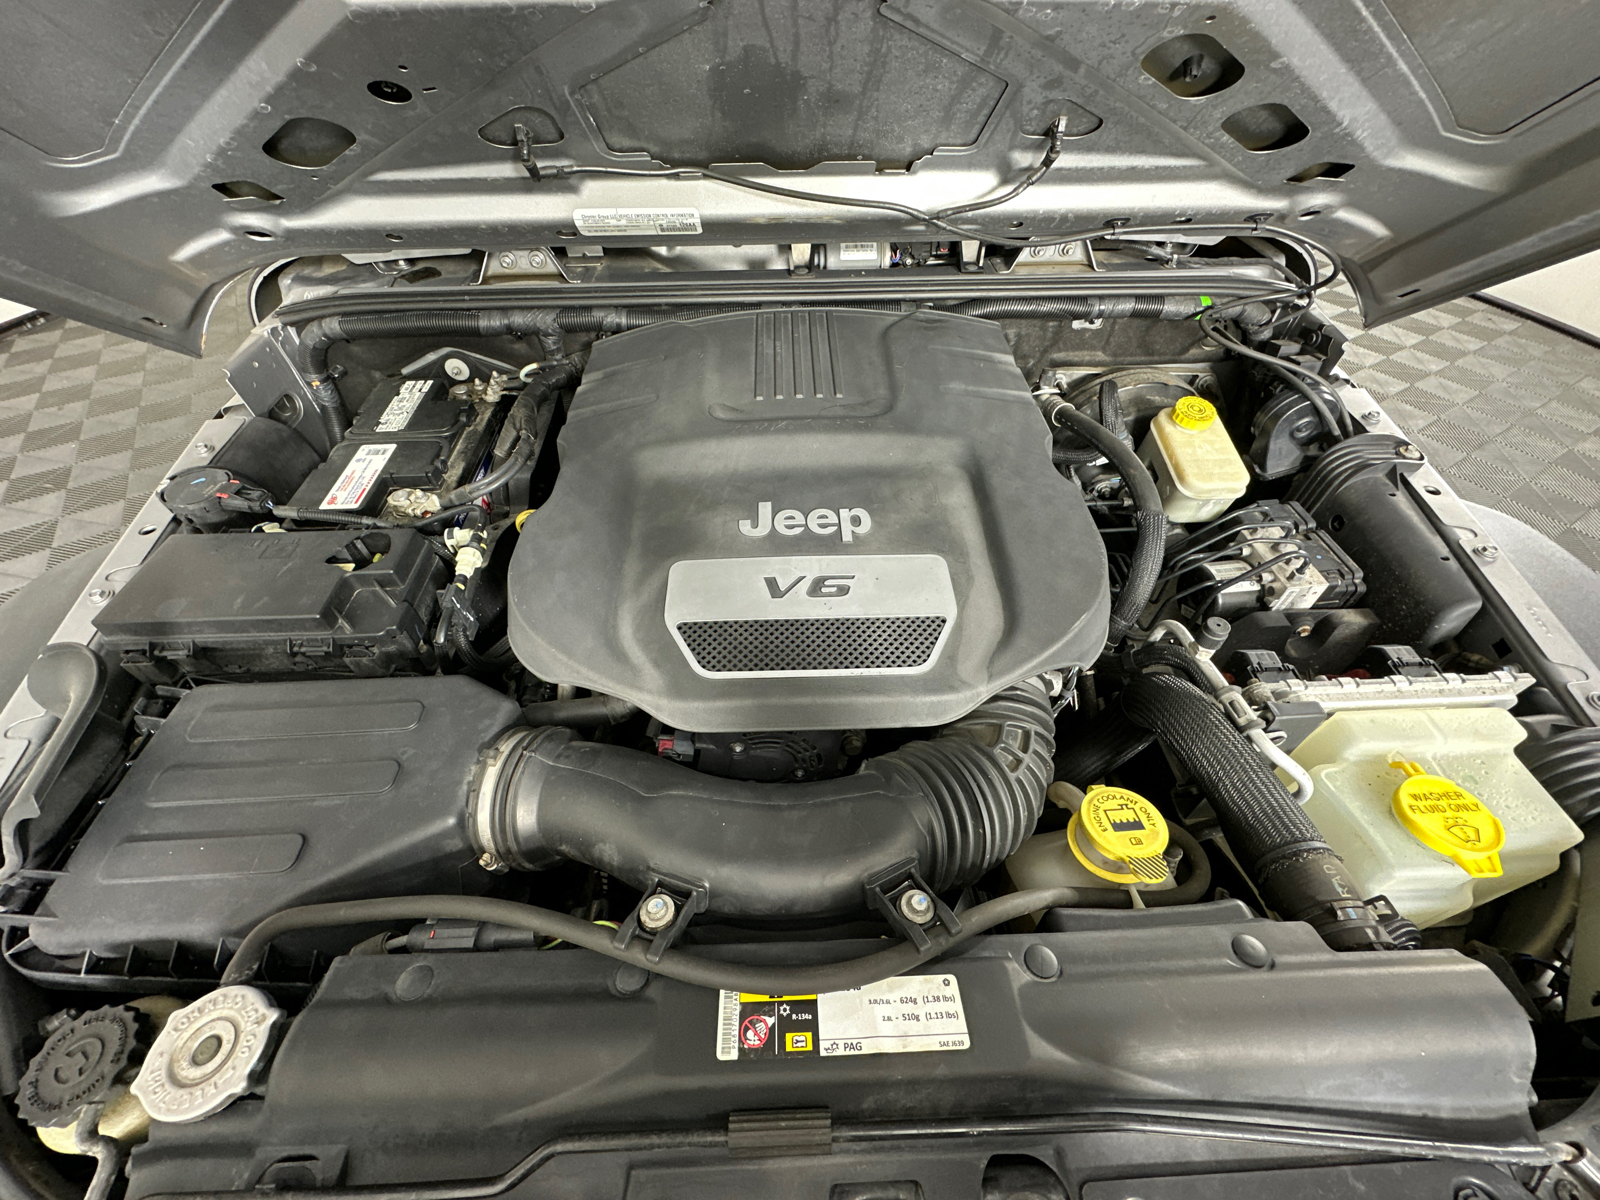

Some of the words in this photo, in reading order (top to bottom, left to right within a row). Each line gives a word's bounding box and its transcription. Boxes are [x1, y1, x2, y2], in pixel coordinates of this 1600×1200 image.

[738, 501, 872, 543] Jeep
[763, 574, 856, 599] V6
[1096, 793, 1139, 806] COOLANT
[1408, 791, 1466, 802] WASHER
[1409, 804, 1446, 815] FLUID
[1448, 802, 1481, 813] ONLY
[1092, 803, 1108, 833] ENGINE
[1139, 806, 1157, 829] ONLY
[899, 996, 918, 1007] 624g
[922, 995, 941, 1006] (1.38
[941, 994, 956, 1005] lbs)
[791, 1012, 812, 1021] R-134a
[902, 1012, 920, 1023] 510g
[925, 1011, 944, 1022] (1.13
[945, 1010, 959, 1021] lbs)
[844, 1042, 863, 1052] PAG
